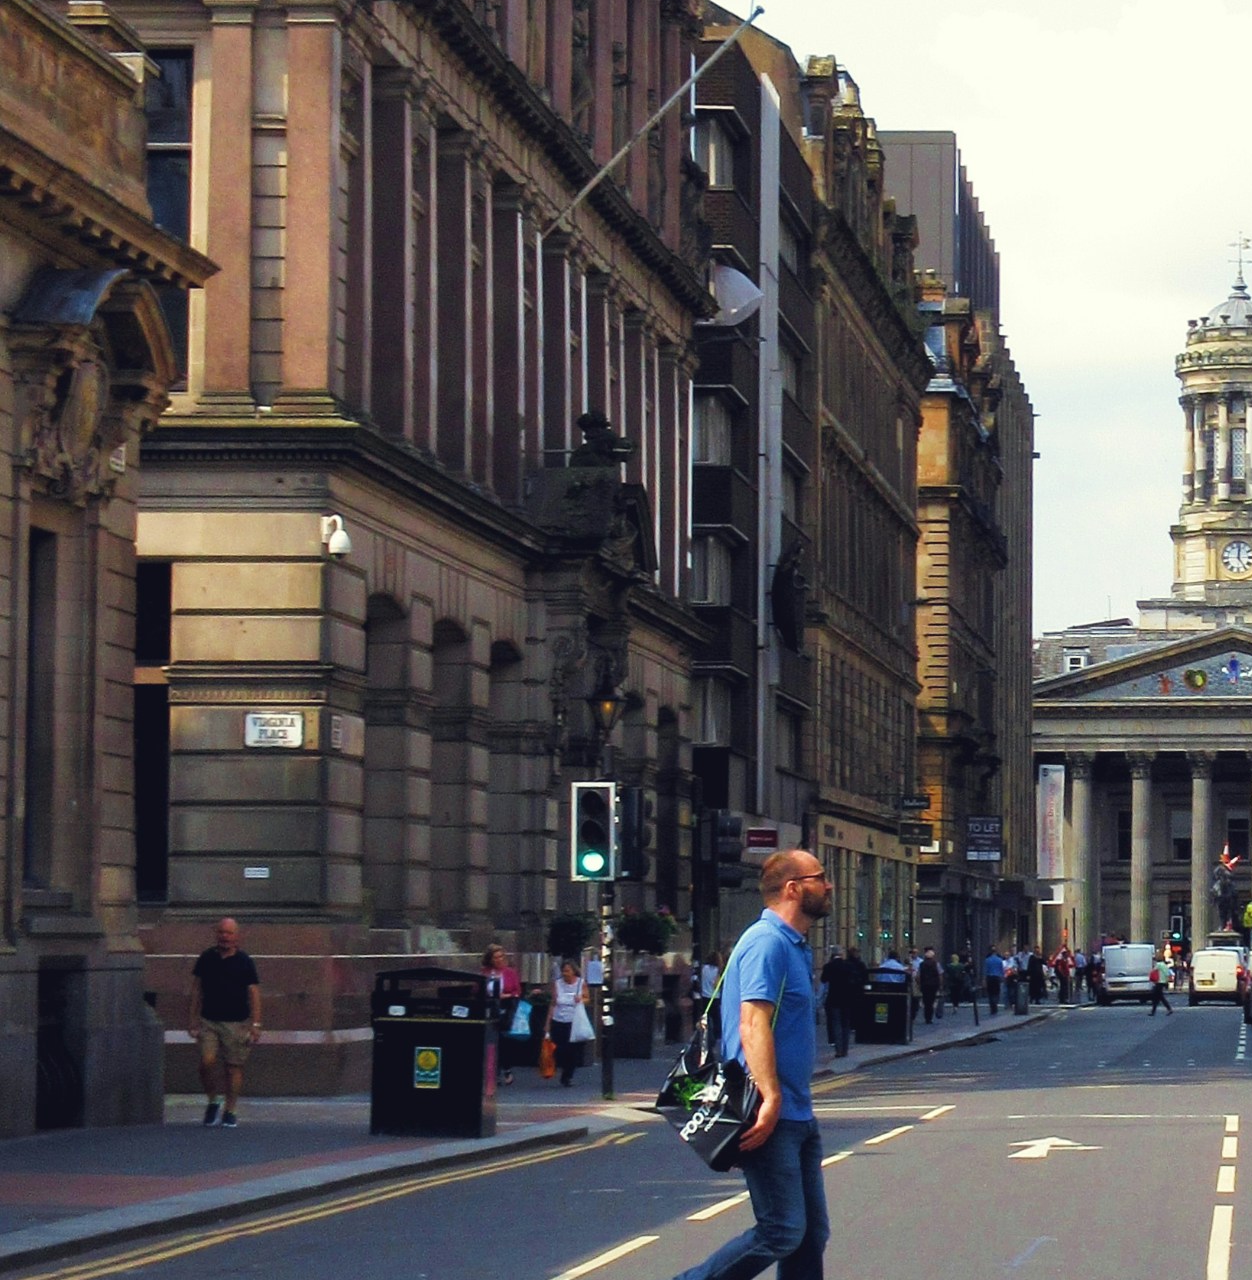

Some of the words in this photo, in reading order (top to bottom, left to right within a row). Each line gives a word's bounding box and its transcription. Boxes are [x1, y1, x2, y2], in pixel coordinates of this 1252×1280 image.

[251, 716, 296, 728] VIRGINIA
[257, 728, 288, 740] PLACE
[968, 823, 981, 832] TO
[983, 823, 1000, 832] LET
